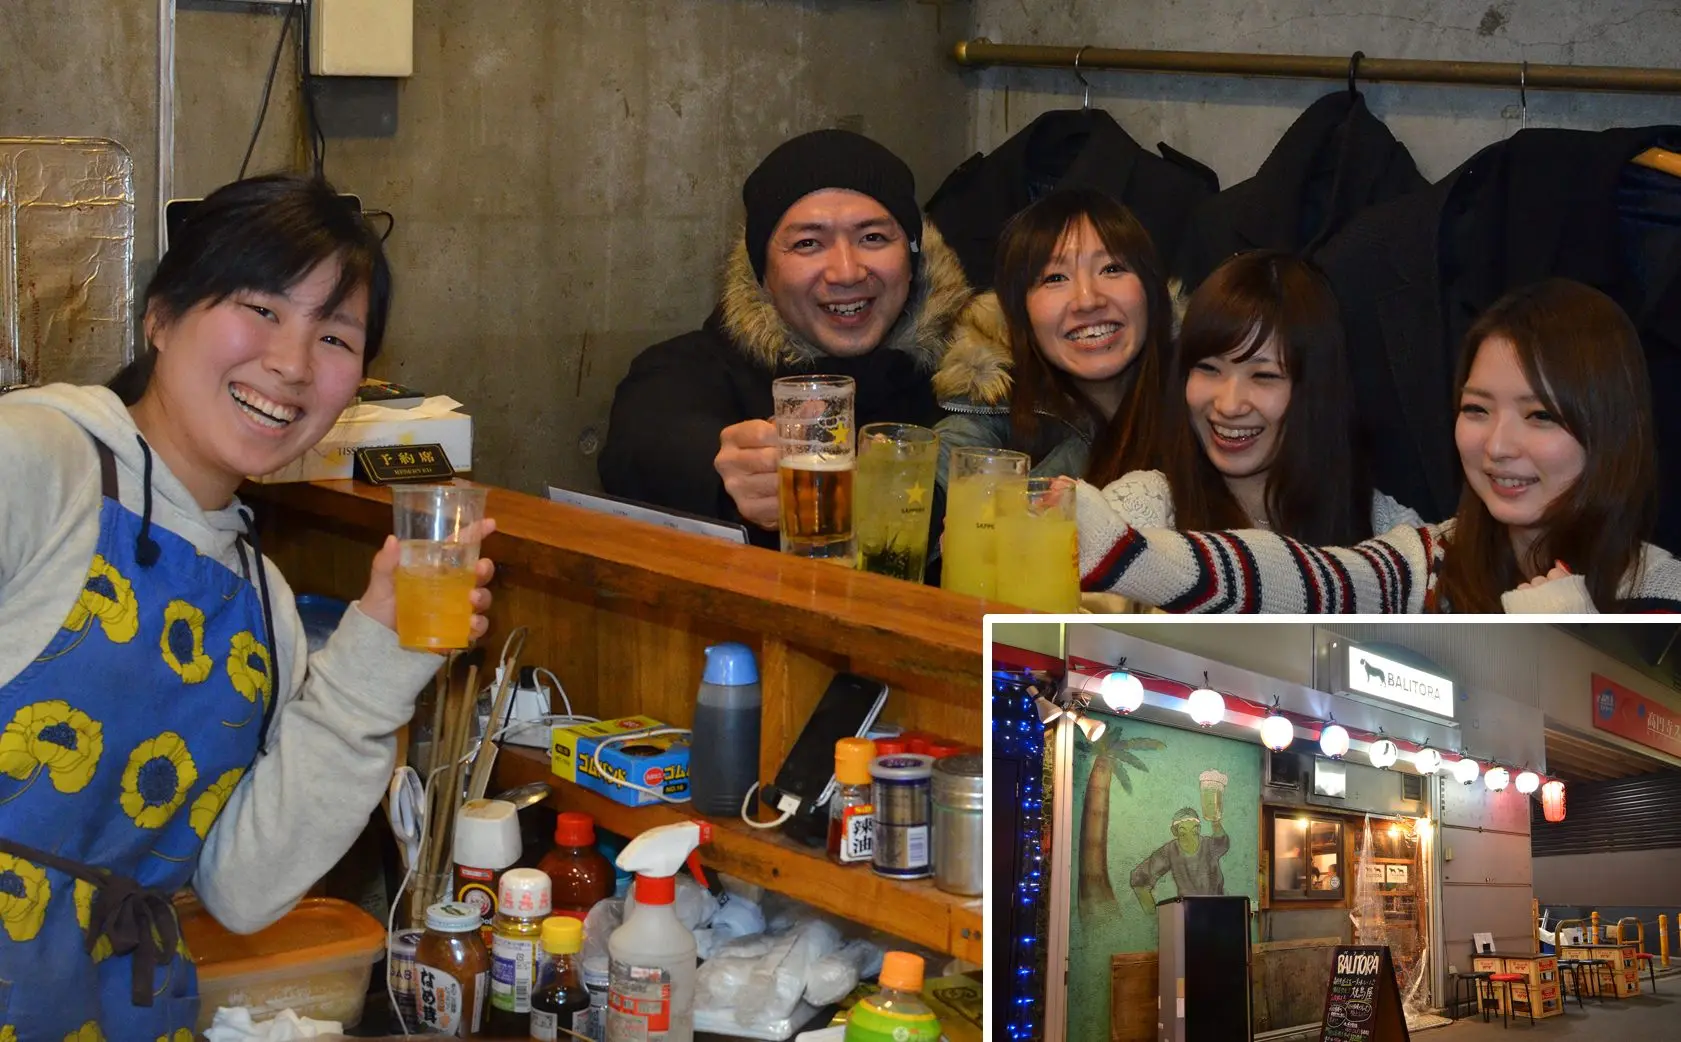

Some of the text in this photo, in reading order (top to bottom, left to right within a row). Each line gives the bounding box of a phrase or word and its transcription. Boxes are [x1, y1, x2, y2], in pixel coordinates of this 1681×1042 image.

[380, 451, 435, 466] 予約席
[1387, 672, 1441, 700] BALITORA
[1337, 954, 1380, 976] BALITORA
